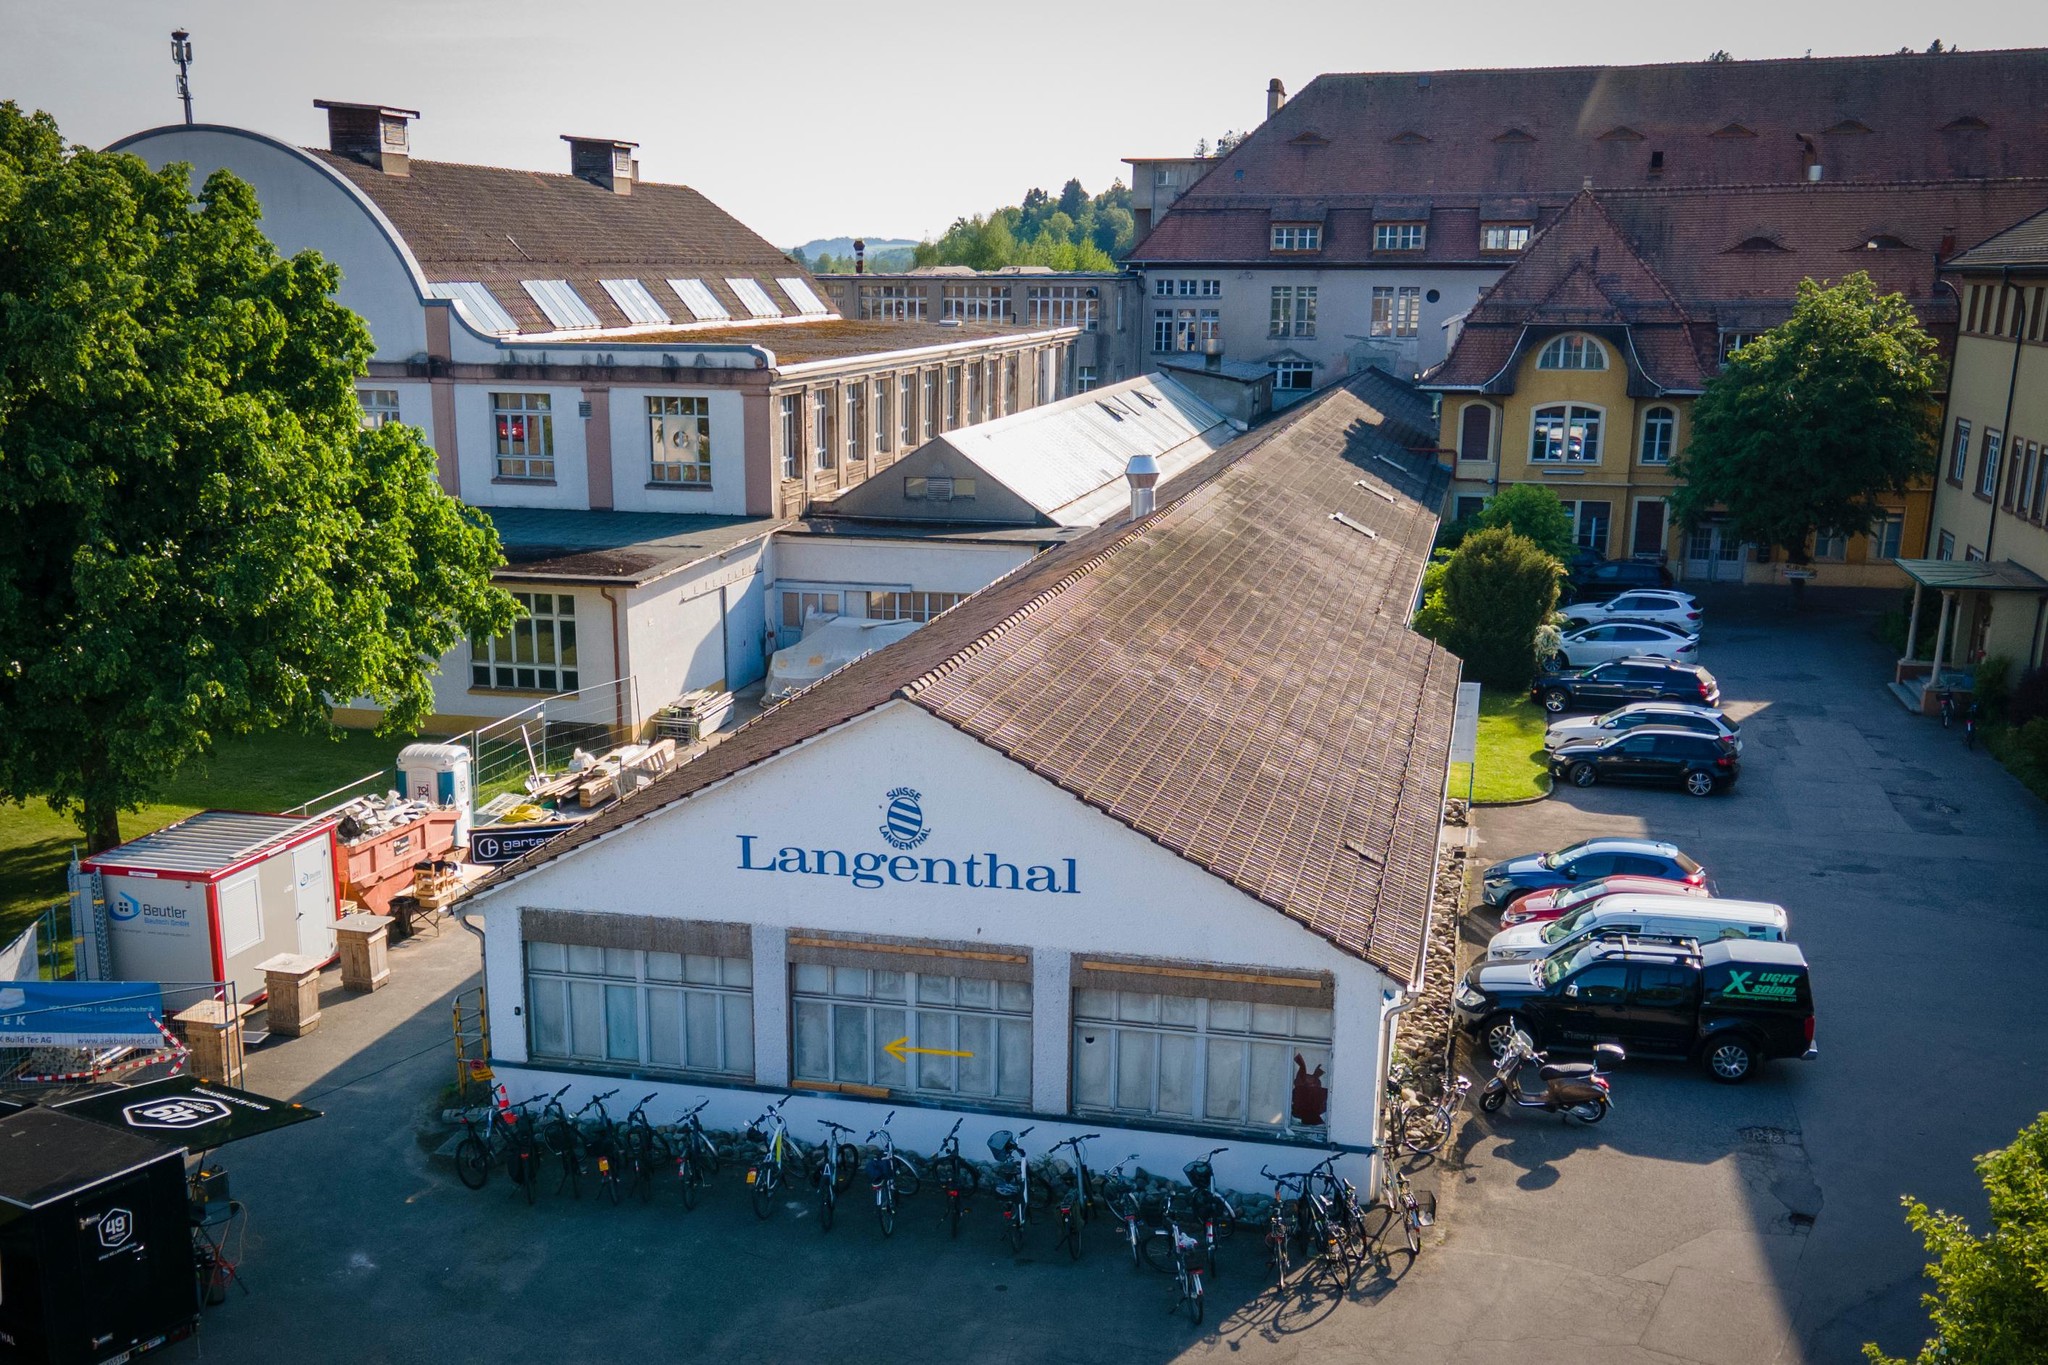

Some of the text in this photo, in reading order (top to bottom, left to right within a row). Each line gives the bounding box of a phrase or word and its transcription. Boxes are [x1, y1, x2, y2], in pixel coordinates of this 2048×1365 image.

[886, 787, 922, 801] SUISSE
[879, 825, 931, 850] LANGENTHAL
[736, 835, 1081, 894] Langenthal
[143, 903, 187, 919] Beutler
[1759, 972, 1799, 983] LIGHT
[1753, 985, 1796, 994] SOUND
[5, 1035, 25, 1043] Build
[105, 1216, 125, 1234] 49
